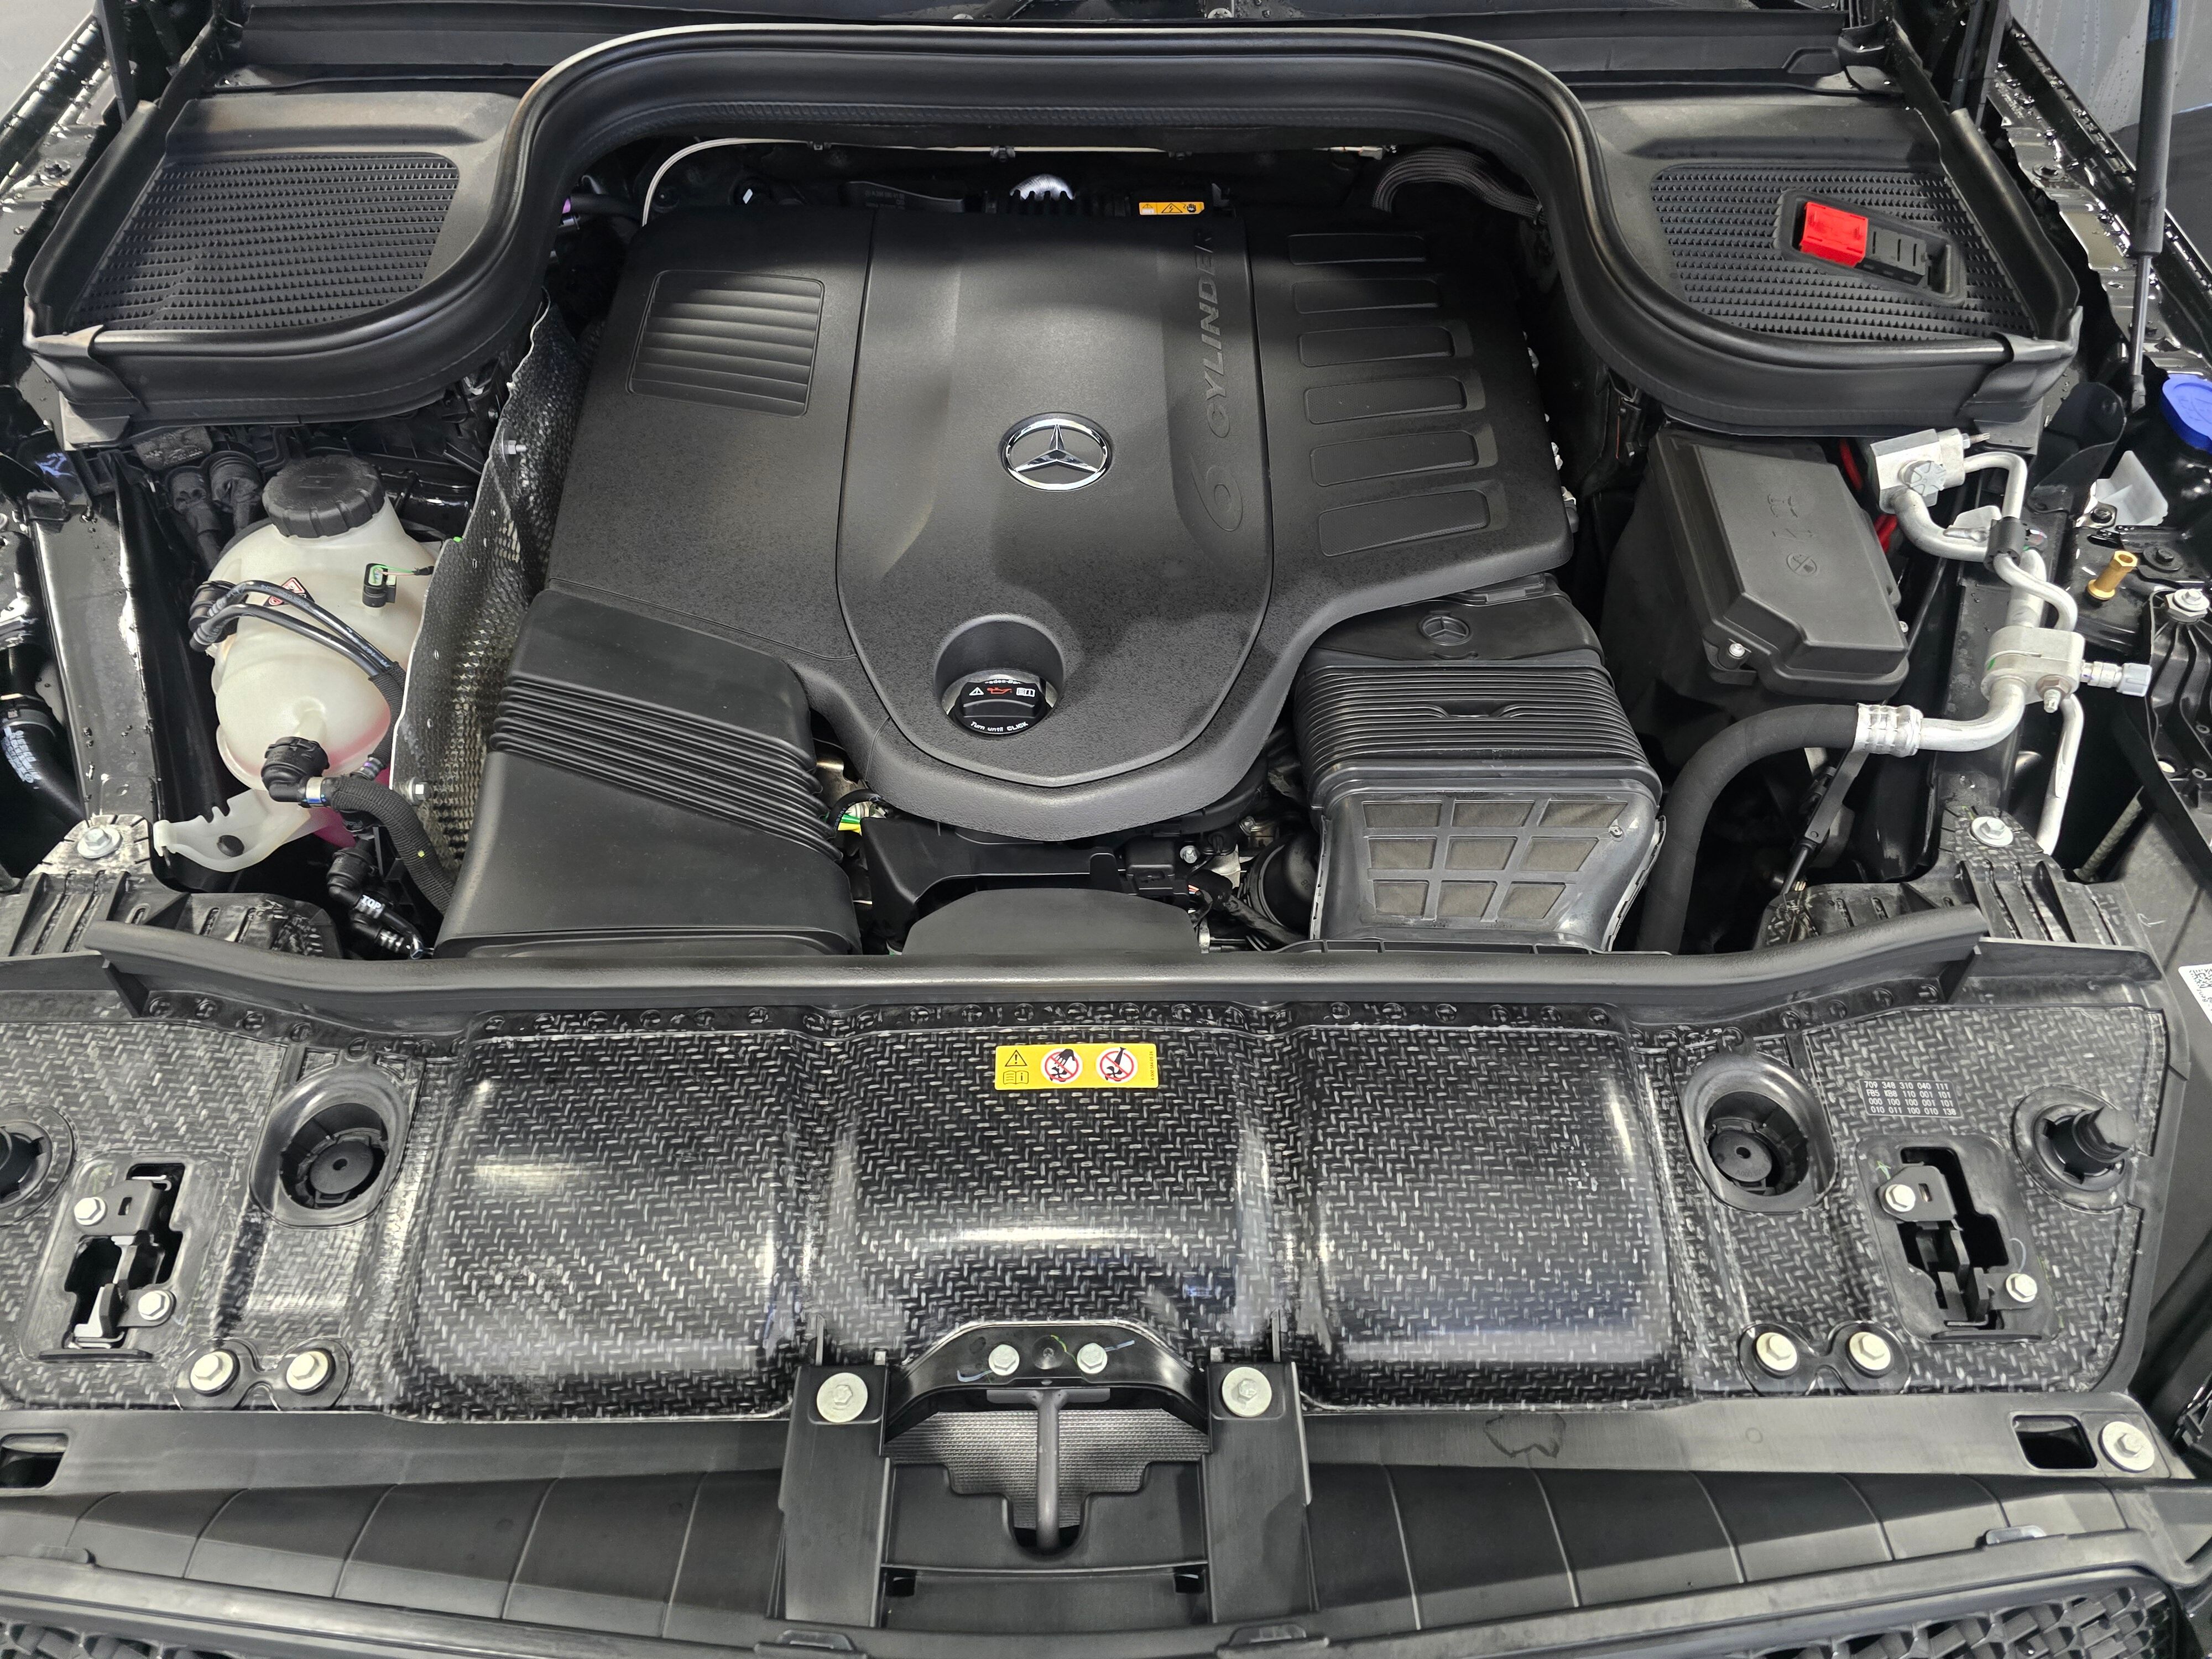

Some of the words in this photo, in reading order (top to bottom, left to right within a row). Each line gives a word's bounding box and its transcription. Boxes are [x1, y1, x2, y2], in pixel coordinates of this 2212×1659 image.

[971, 721, 985, 730] Turn
[1006, 721, 1029, 731] CLICK
[362, 894, 382, 909] TOP
